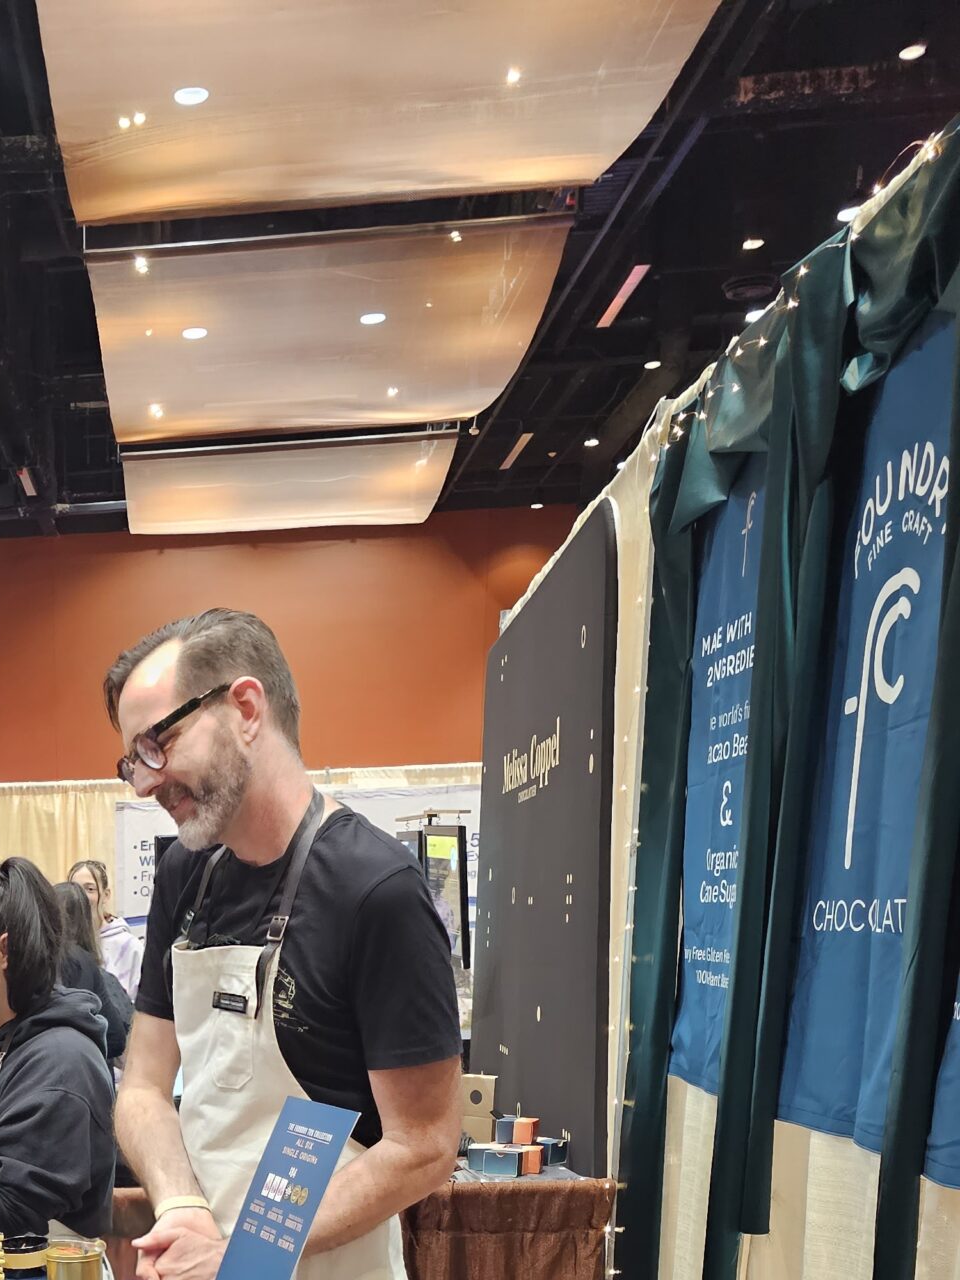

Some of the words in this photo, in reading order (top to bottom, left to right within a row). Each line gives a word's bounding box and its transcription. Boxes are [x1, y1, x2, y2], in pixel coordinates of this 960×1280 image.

[854, 440, 950, 580] FOUNDR
[867, 520, 893, 572] FINE
[901, 509, 933, 545] CRAFT
[726, 611, 752, 644] WITH
[502, 748, 528, 795] Melissa
[530, 716, 561, 789] Coppel
[706, 740, 731, 765] acao
[720, 780, 732, 827] &
[706, 844, 739, 877] Organic
[812, 899, 907, 933] CHOCOLAT
